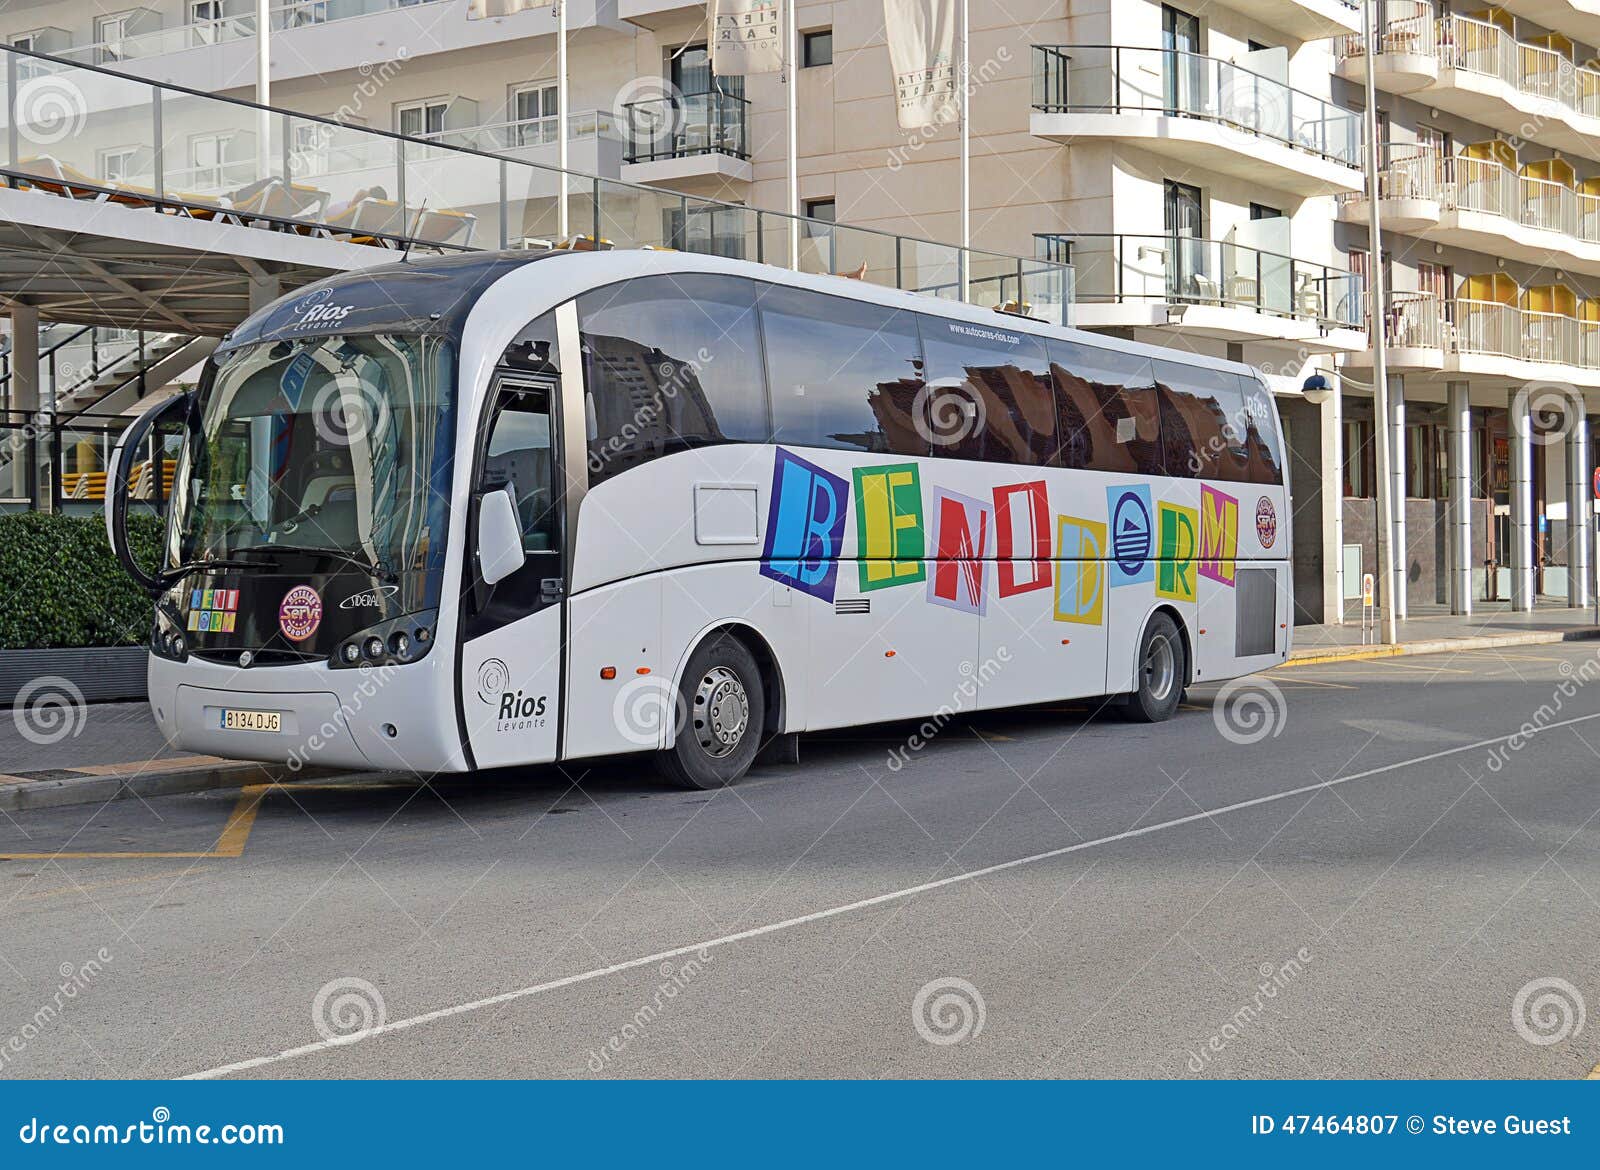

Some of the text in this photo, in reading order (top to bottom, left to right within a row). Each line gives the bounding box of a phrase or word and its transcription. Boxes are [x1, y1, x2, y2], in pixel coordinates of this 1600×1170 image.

[300, 302, 355, 324] Rios
[286, 625, 311, 636] GROUP
[499, 690, 547, 719] Rios
[227, 712, 278, 729] 8134 DJG
[497, 719, 545, 732] Levante
